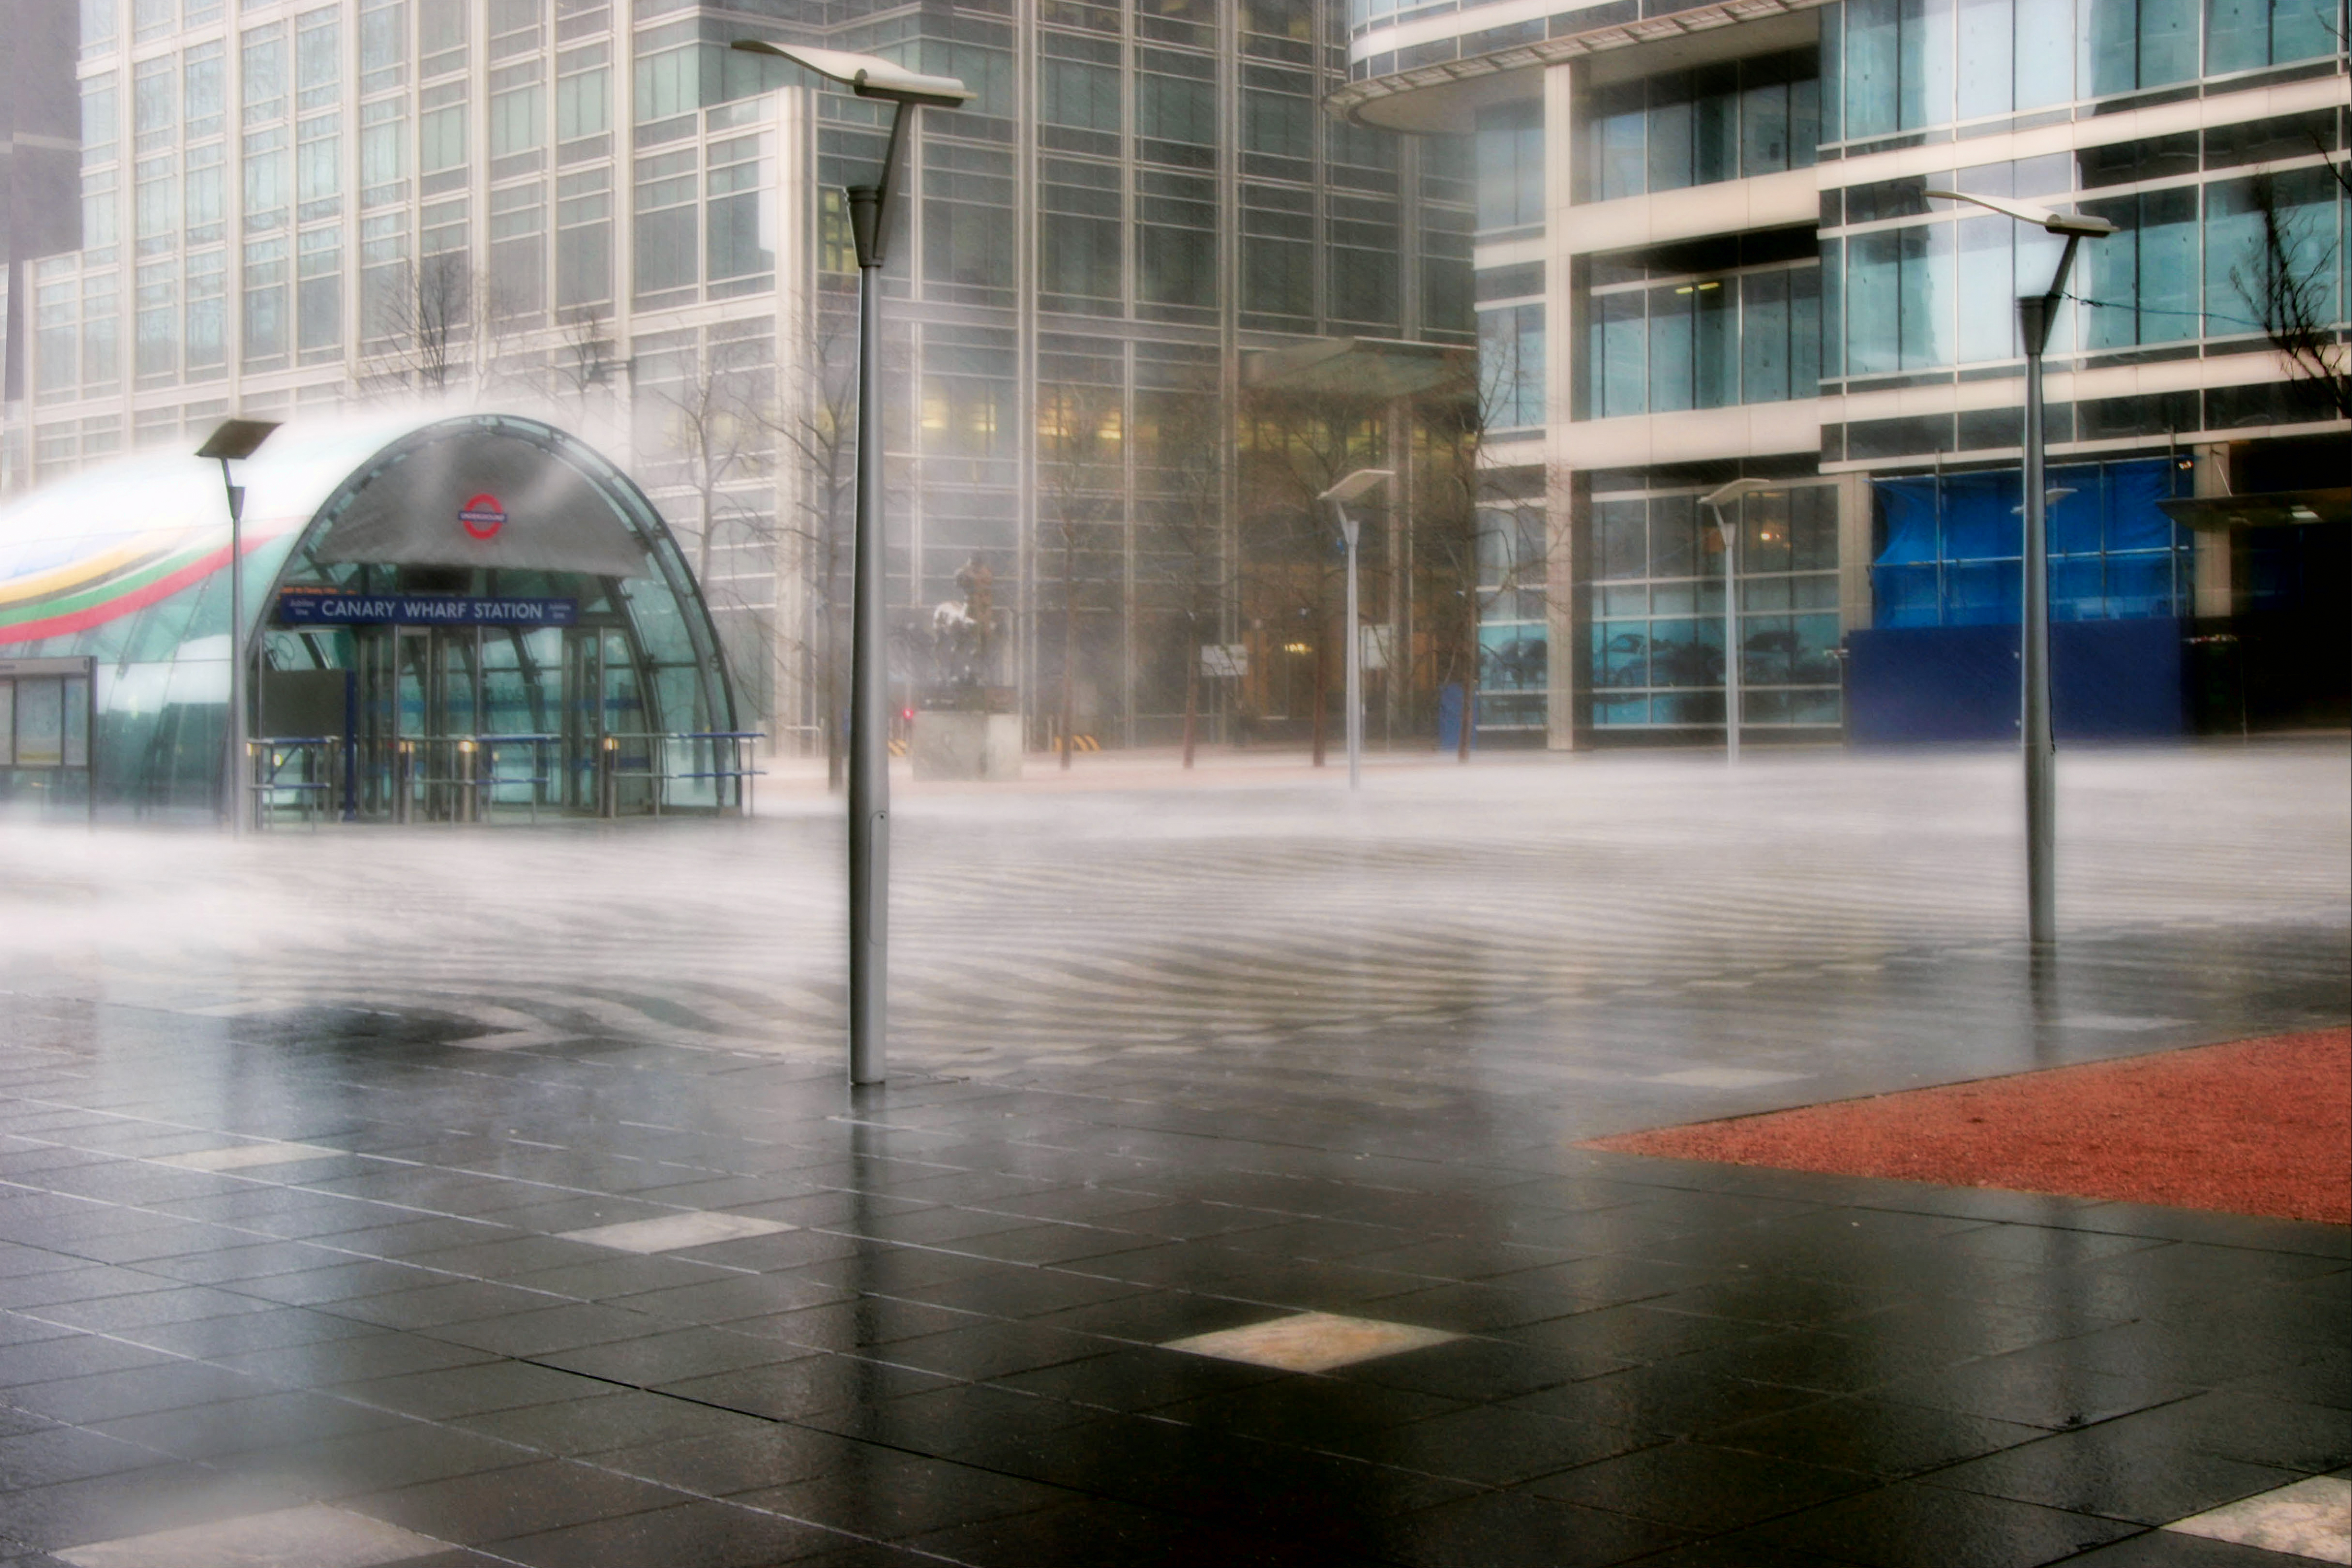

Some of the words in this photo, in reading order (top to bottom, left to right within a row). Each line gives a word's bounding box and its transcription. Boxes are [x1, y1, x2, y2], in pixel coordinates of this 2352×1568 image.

[321, 601, 396, 617] CANARY
[403, 602, 467, 618] WHARF
[474, 603, 542, 619] STATION
